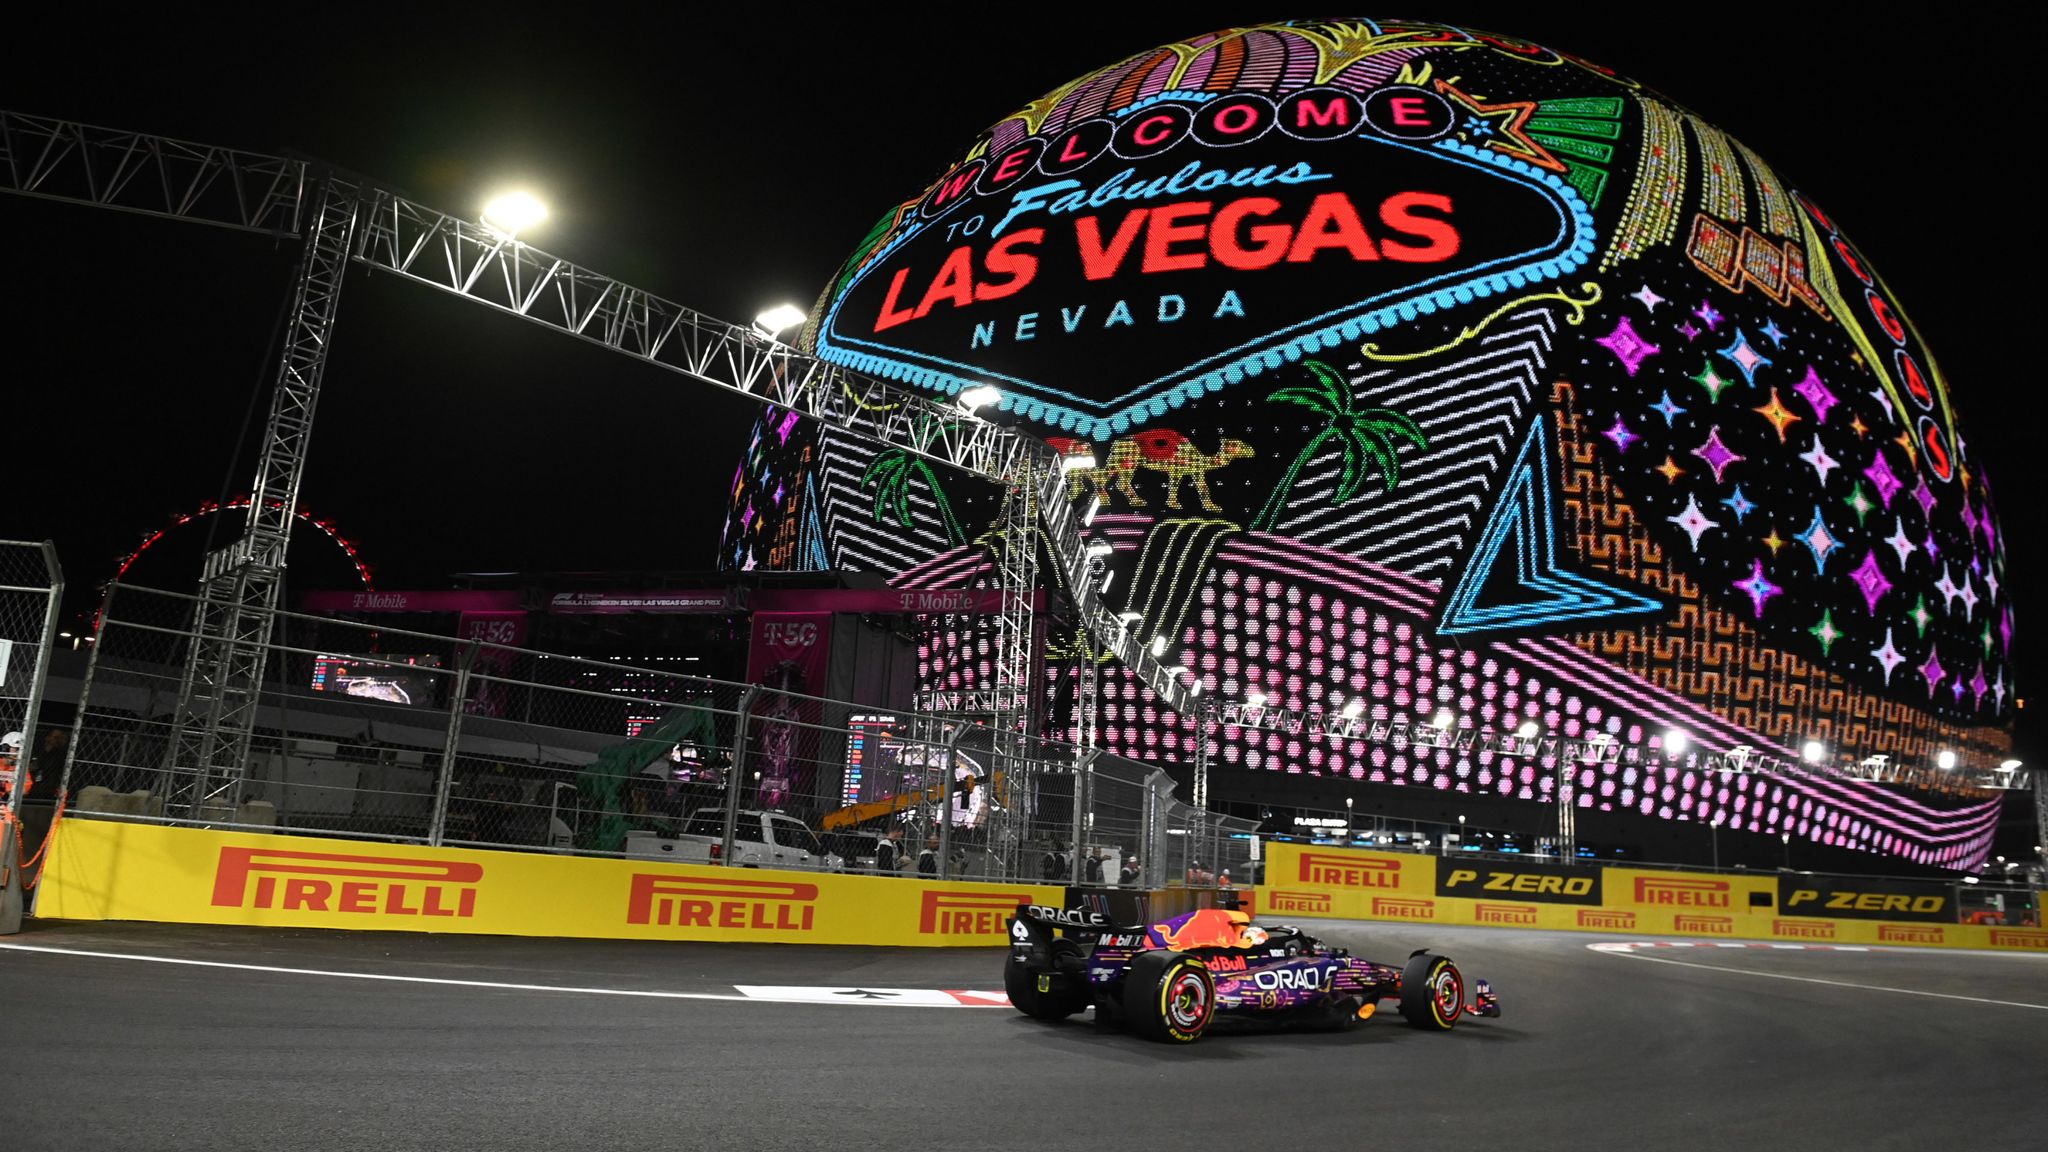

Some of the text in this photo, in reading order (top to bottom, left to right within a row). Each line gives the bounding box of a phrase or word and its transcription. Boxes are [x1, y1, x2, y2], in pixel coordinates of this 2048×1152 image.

[934, 96, 1432, 206] WELCOME
[946, 160, 1333, 242] TO Fabulous
[874, 191, 1460, 333] LAS VEGAS
[970, 290, 1246, 350] NEVADA
[366, 593, 407, 608] Mobile
[917, 592, 973, 610] Mobile
[1300, 852, 1401, 888] PIRELLI
[211, 846, 484, 917] PIRELLI
[1446, 869, 1594, 896] P ZERO
[1634, 876, 1730, 908] PIRELLI
[626, 873, 819, 931] PIRELLI
[919, 890, 1033, 934] PIREL
[1269, 890, 1331, 913] PIRELLI
[1372, 897, 1435, 919] PIRELLI
[1788, 890, 1945, 913] P ZERO
[1028, 905, 1104, 926] ORACLE
[1475, 904, 1537, 925] PIRELLI
[1577, 909, 1636, 930] PIRELLI
[1674, 914, 1733, 934] PIRELLI
[1773, 919, 1835, 938] PIRELLI
[1878, 924, 1944, 944] PIRELLI
[1990, 928, 2048, 948] PIREL
[1098, 933, 1133, 947] Mobil
[1196, 955, 1248, 971] ed Bull
